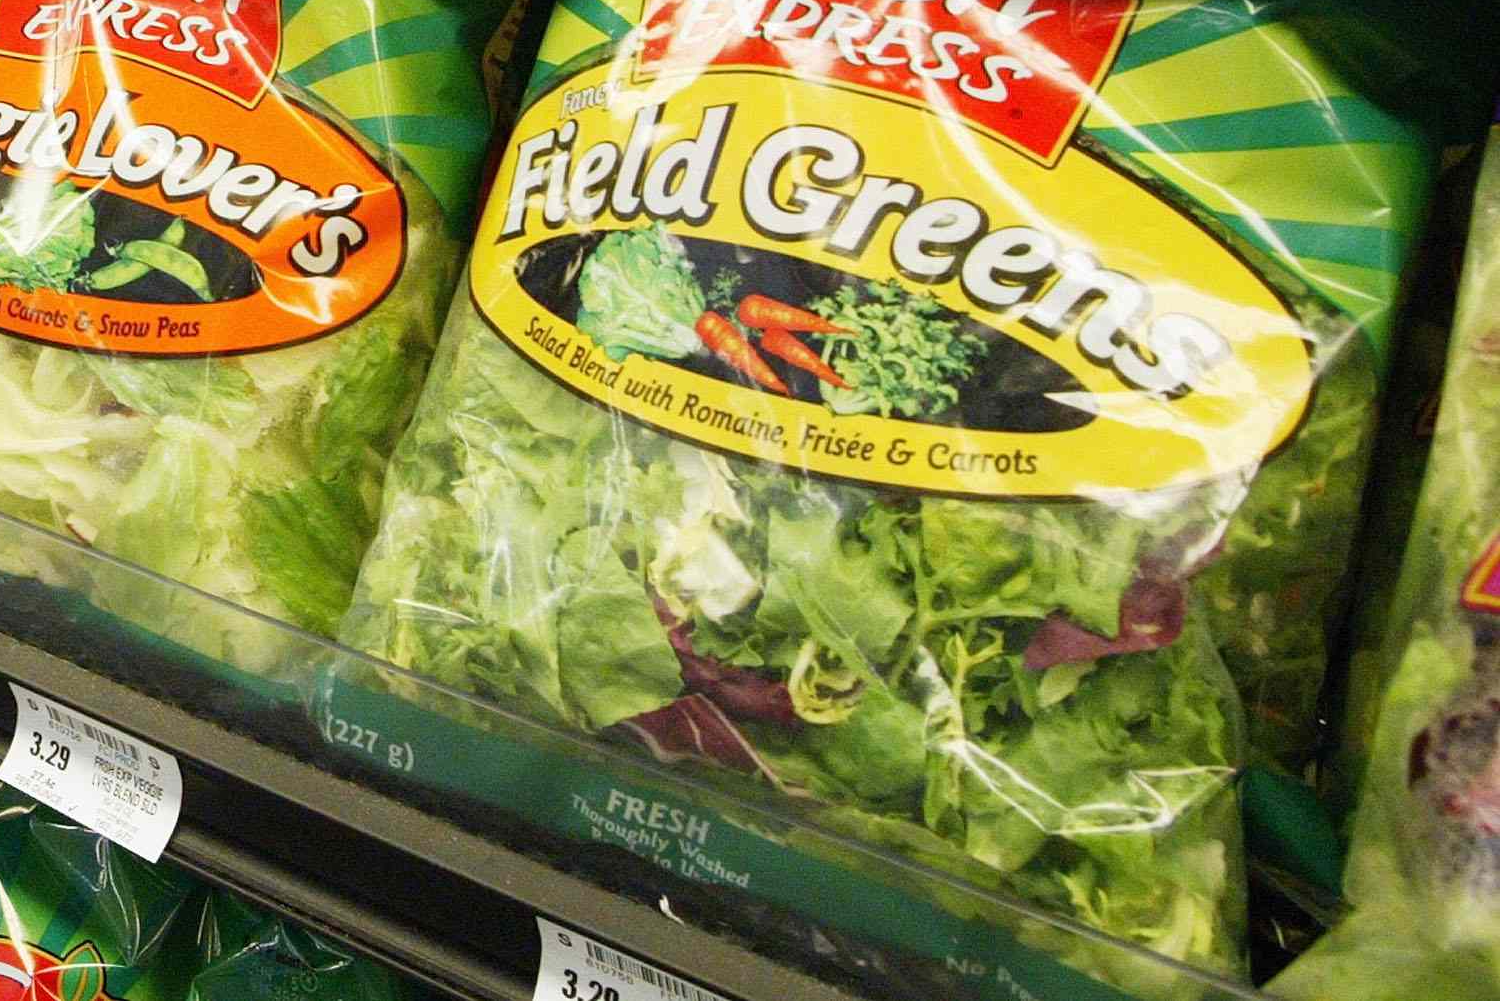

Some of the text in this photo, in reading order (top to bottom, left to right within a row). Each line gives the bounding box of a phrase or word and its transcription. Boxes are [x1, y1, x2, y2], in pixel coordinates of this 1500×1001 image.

[72, 87, 367, 275] Lover's
[500, 101, 1233, 401] Field Greens
[7, 297, 69, 330] Carrots
[99, 312, 150, 338] Snow
[156, 316, 200, 338] Peas
[523, 316, 1039, 476] Salad Blend with Romaine, Frisée & Carrots
[29, 731, 71, 772] 3.29
[322, 708, 416, 773] (227 g)
[570, 792, 671, 854] Thoroughly
[678, 837, 751, 889] Washed
[606, 787, 711, 846] FRESH
[557, 931, 574, 948] S
